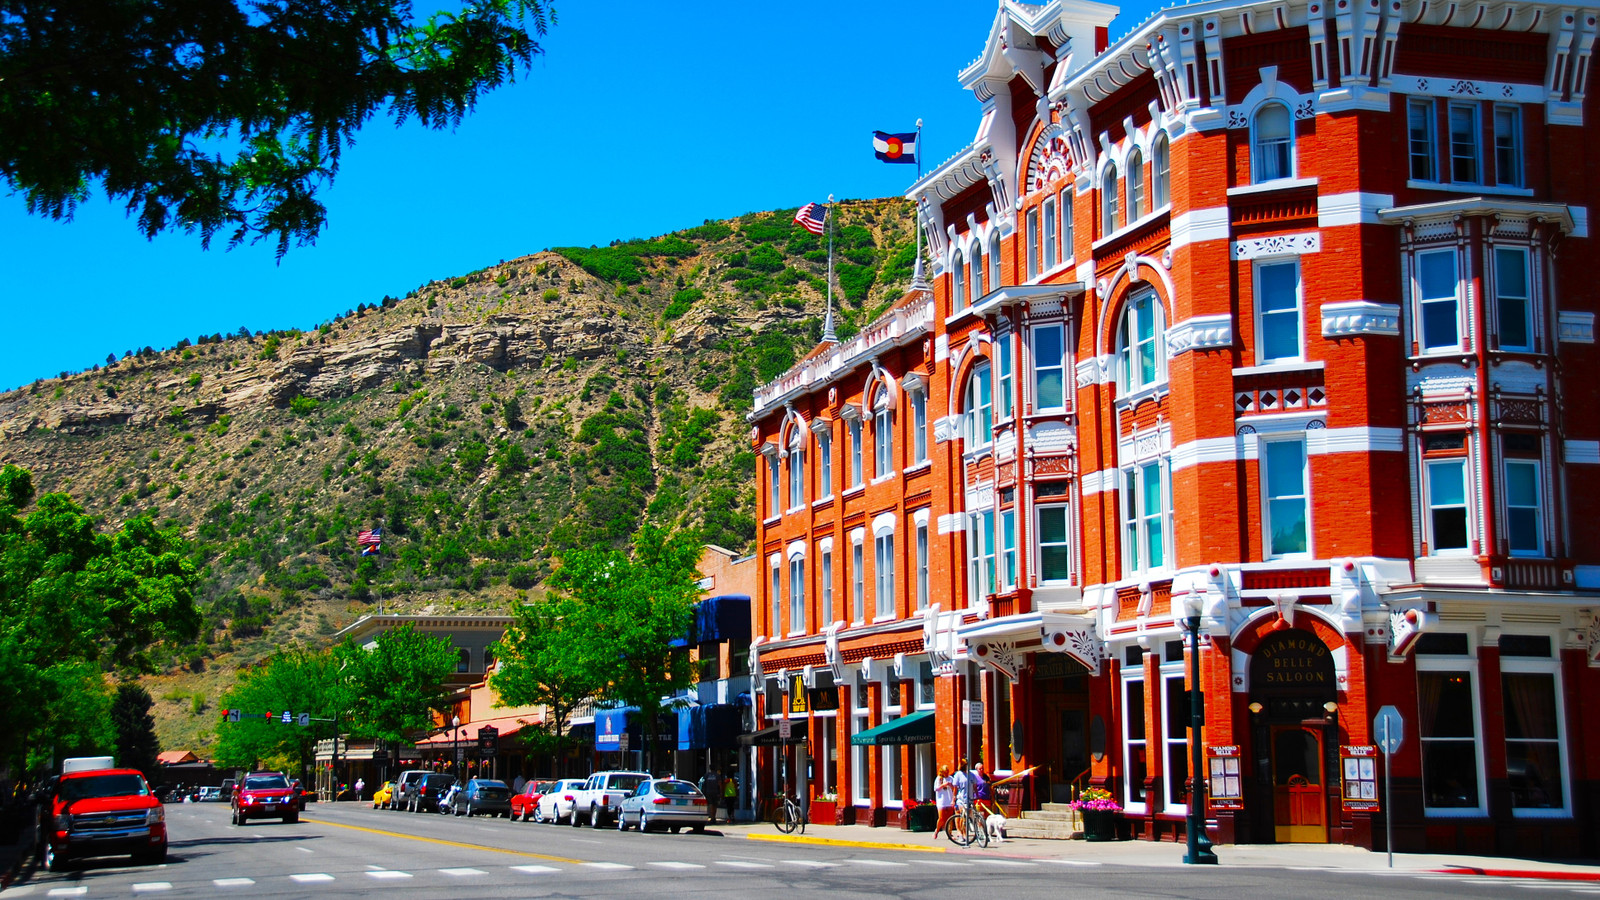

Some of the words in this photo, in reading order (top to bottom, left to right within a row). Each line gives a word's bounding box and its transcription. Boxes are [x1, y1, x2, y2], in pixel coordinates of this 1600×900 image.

[1263, 640, 1325, 658] DIAMOND
[1274, 658, 1313, 668] BELLE
[1266, 671, 1325, 682] SALOON
